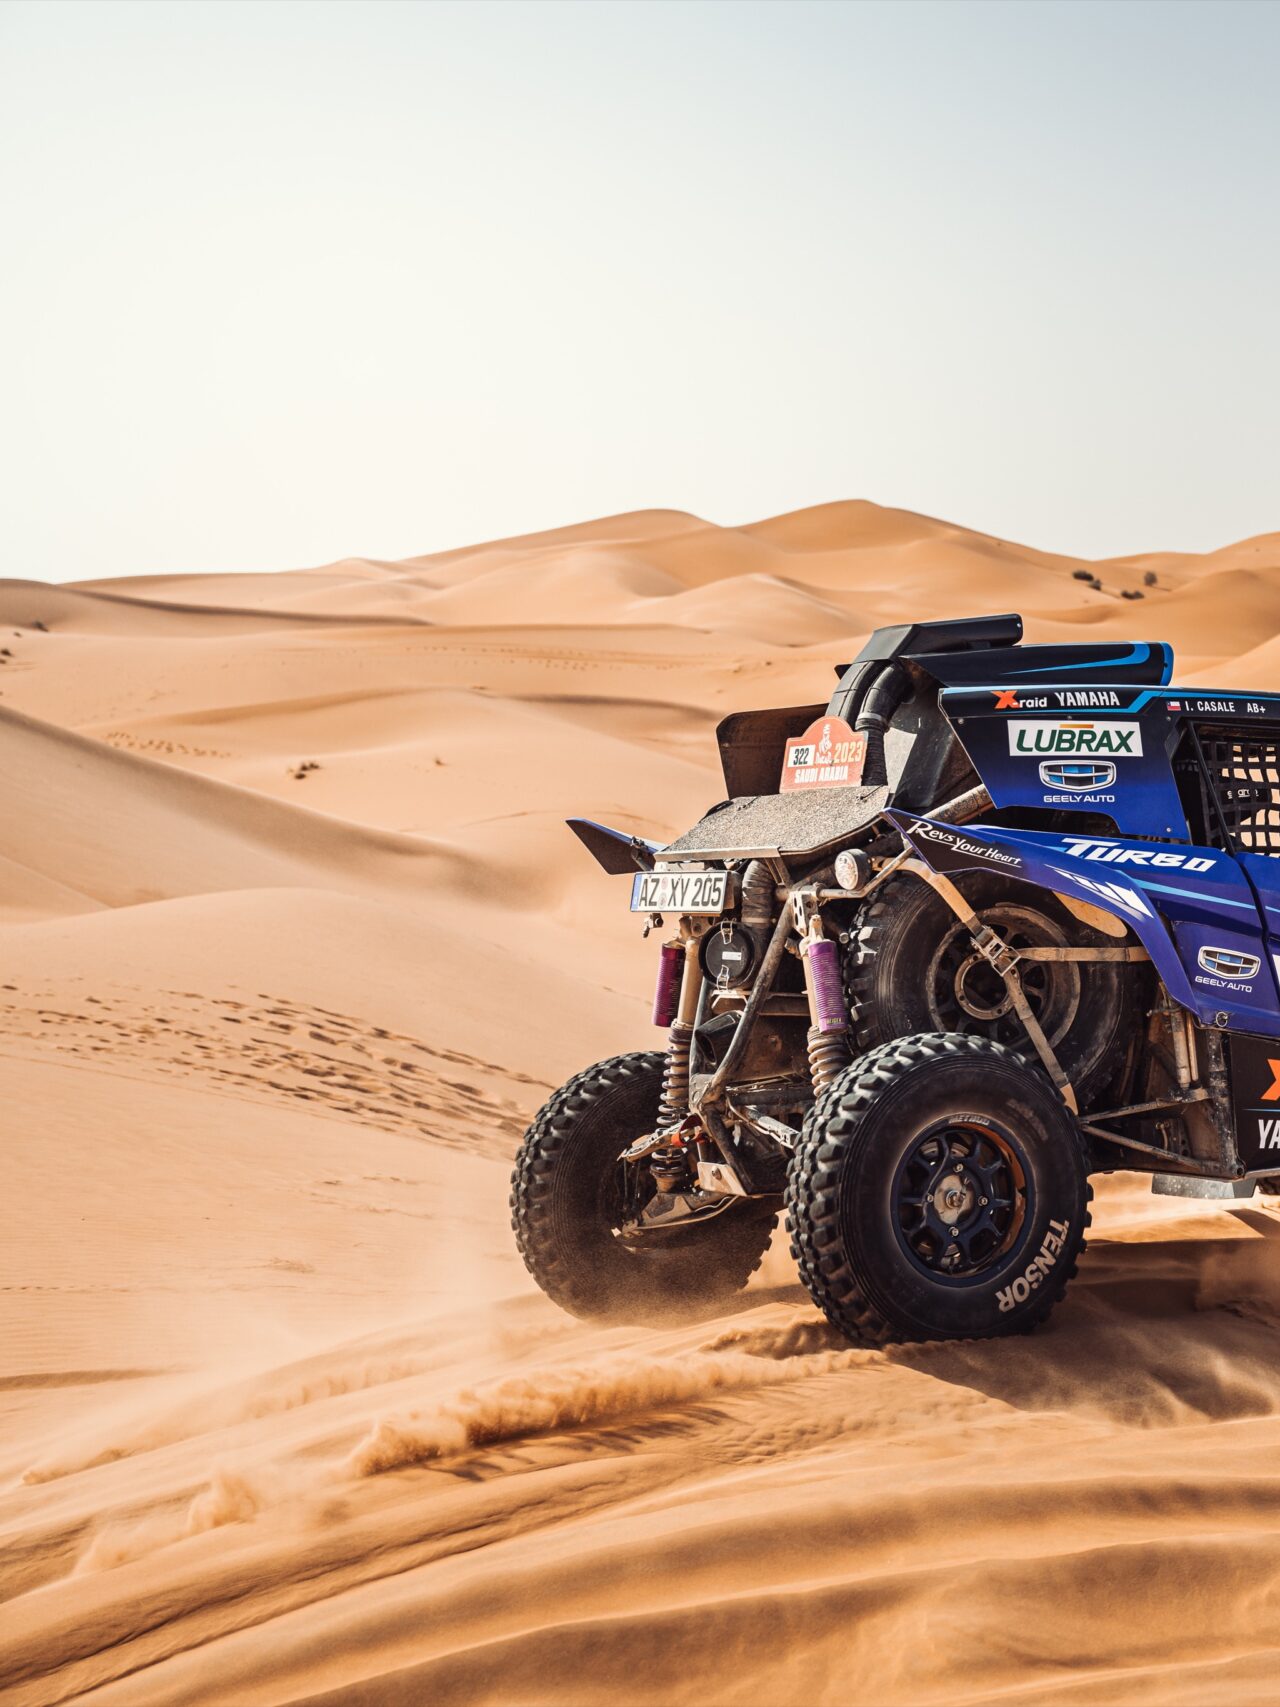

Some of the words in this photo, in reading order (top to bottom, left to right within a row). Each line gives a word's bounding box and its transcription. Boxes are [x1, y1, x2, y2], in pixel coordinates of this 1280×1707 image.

[991, 690, 1047, 709] X-raid
[1055, 691, 1120, 706] YAMAHA
[1197, 701, 1236, 712] CASALE
[1247, 703, 1266, 713] AB+
[1016, 729, 1135, 752] LUBRAX
[793, 748, 809, 765] 322
[833, 741, 864, 763] 2023
[794, 768, 818, 784] SAUDI
[818, 765, 849, 781] ARABIA
[906, 818, 955, 842] Revs
[951, 837, 986, 856] Your
[986, 848, 1022, 864] Heart
[1061, 838, 1216, 872] TURBO
[639, 878, 660, 907] AZ
[668, 878, 690, 907] XY
[691, 877, 723, 906] 205
[1195, 975, 1227, 988] GEELY
[1226, 982, 1252, 993] AUTO
[995, 1219, 1070, 1312] TENSOR
